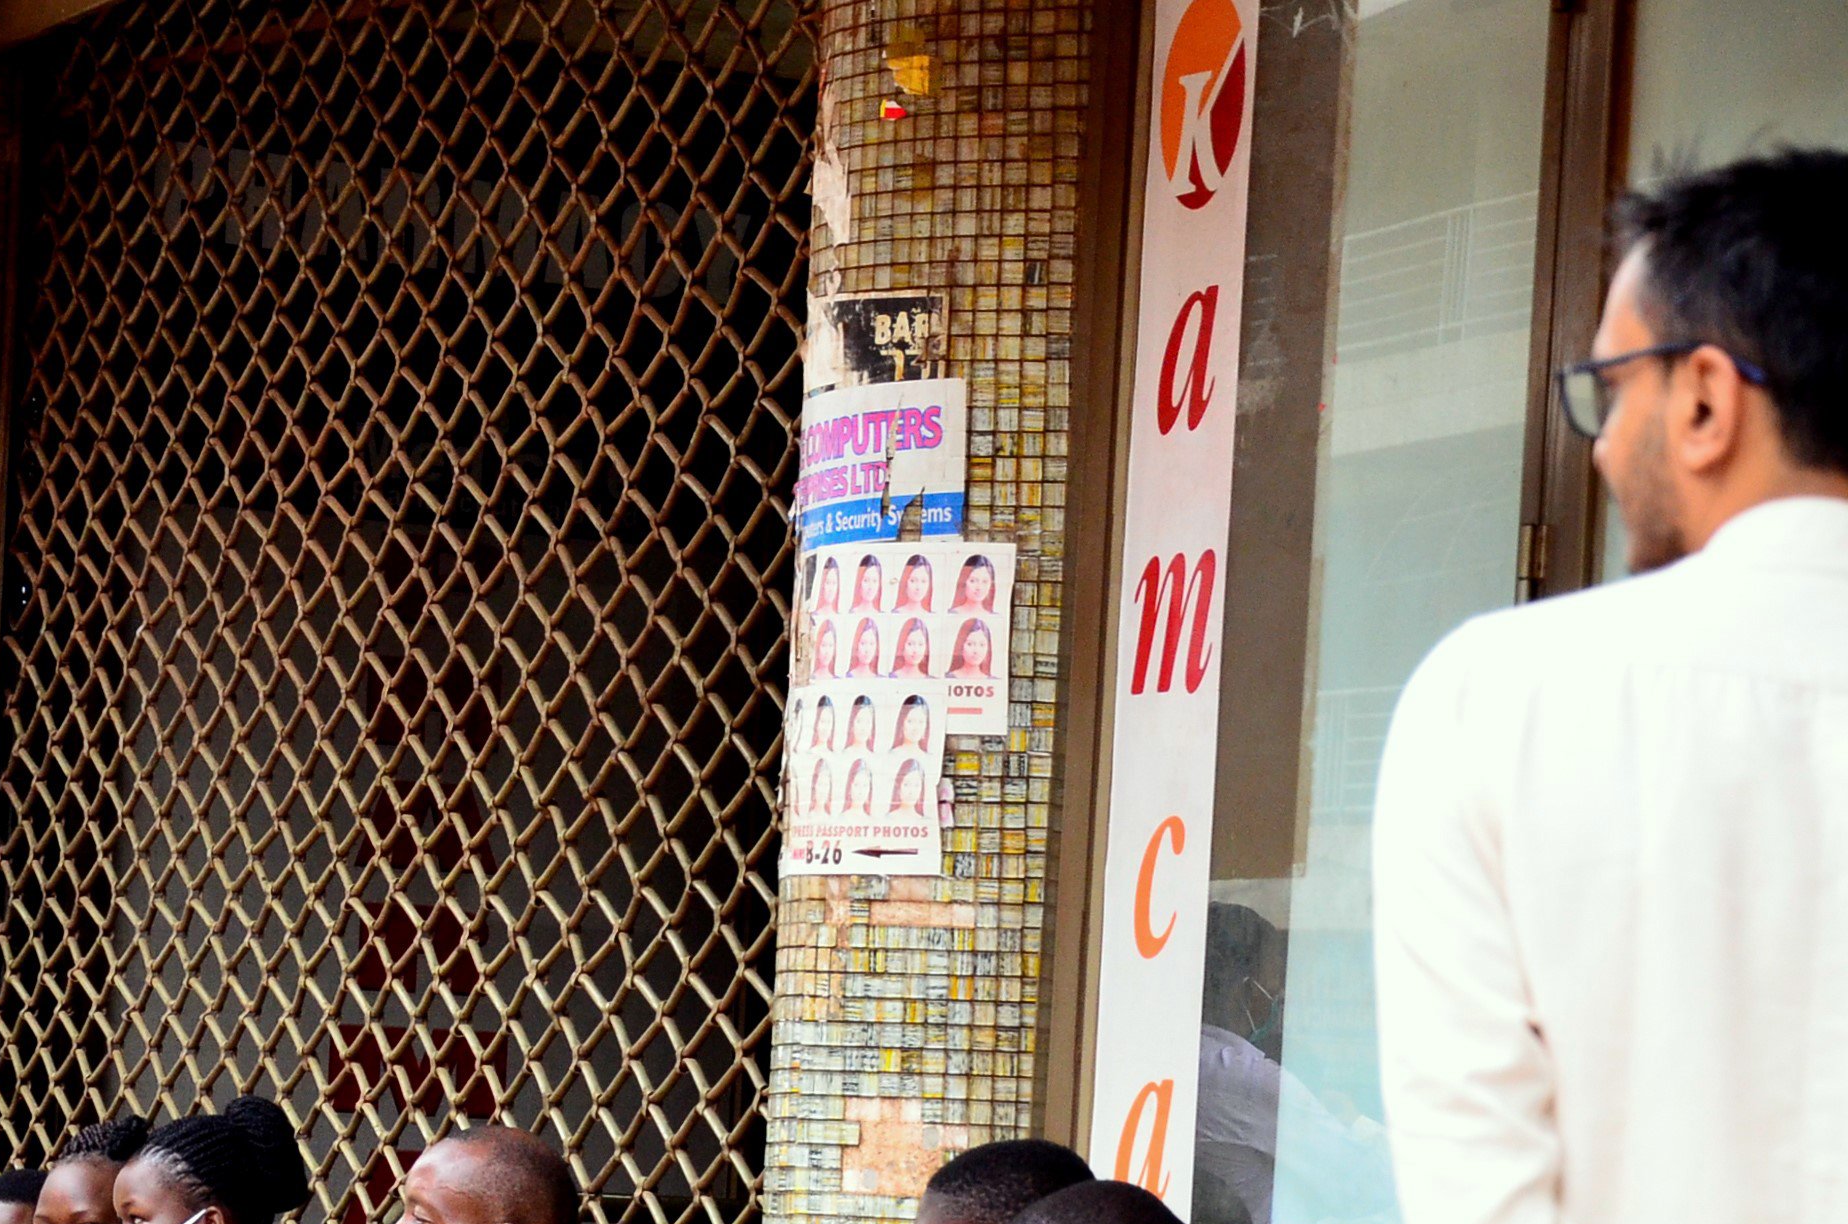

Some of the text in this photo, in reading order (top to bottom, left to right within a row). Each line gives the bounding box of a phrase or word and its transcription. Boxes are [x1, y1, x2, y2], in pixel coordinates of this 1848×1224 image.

[806, 405, 944, 466] COMPUTERS
[835, 507, 883, 533] Security
[873, 826, 929, 838] PHOTOS
